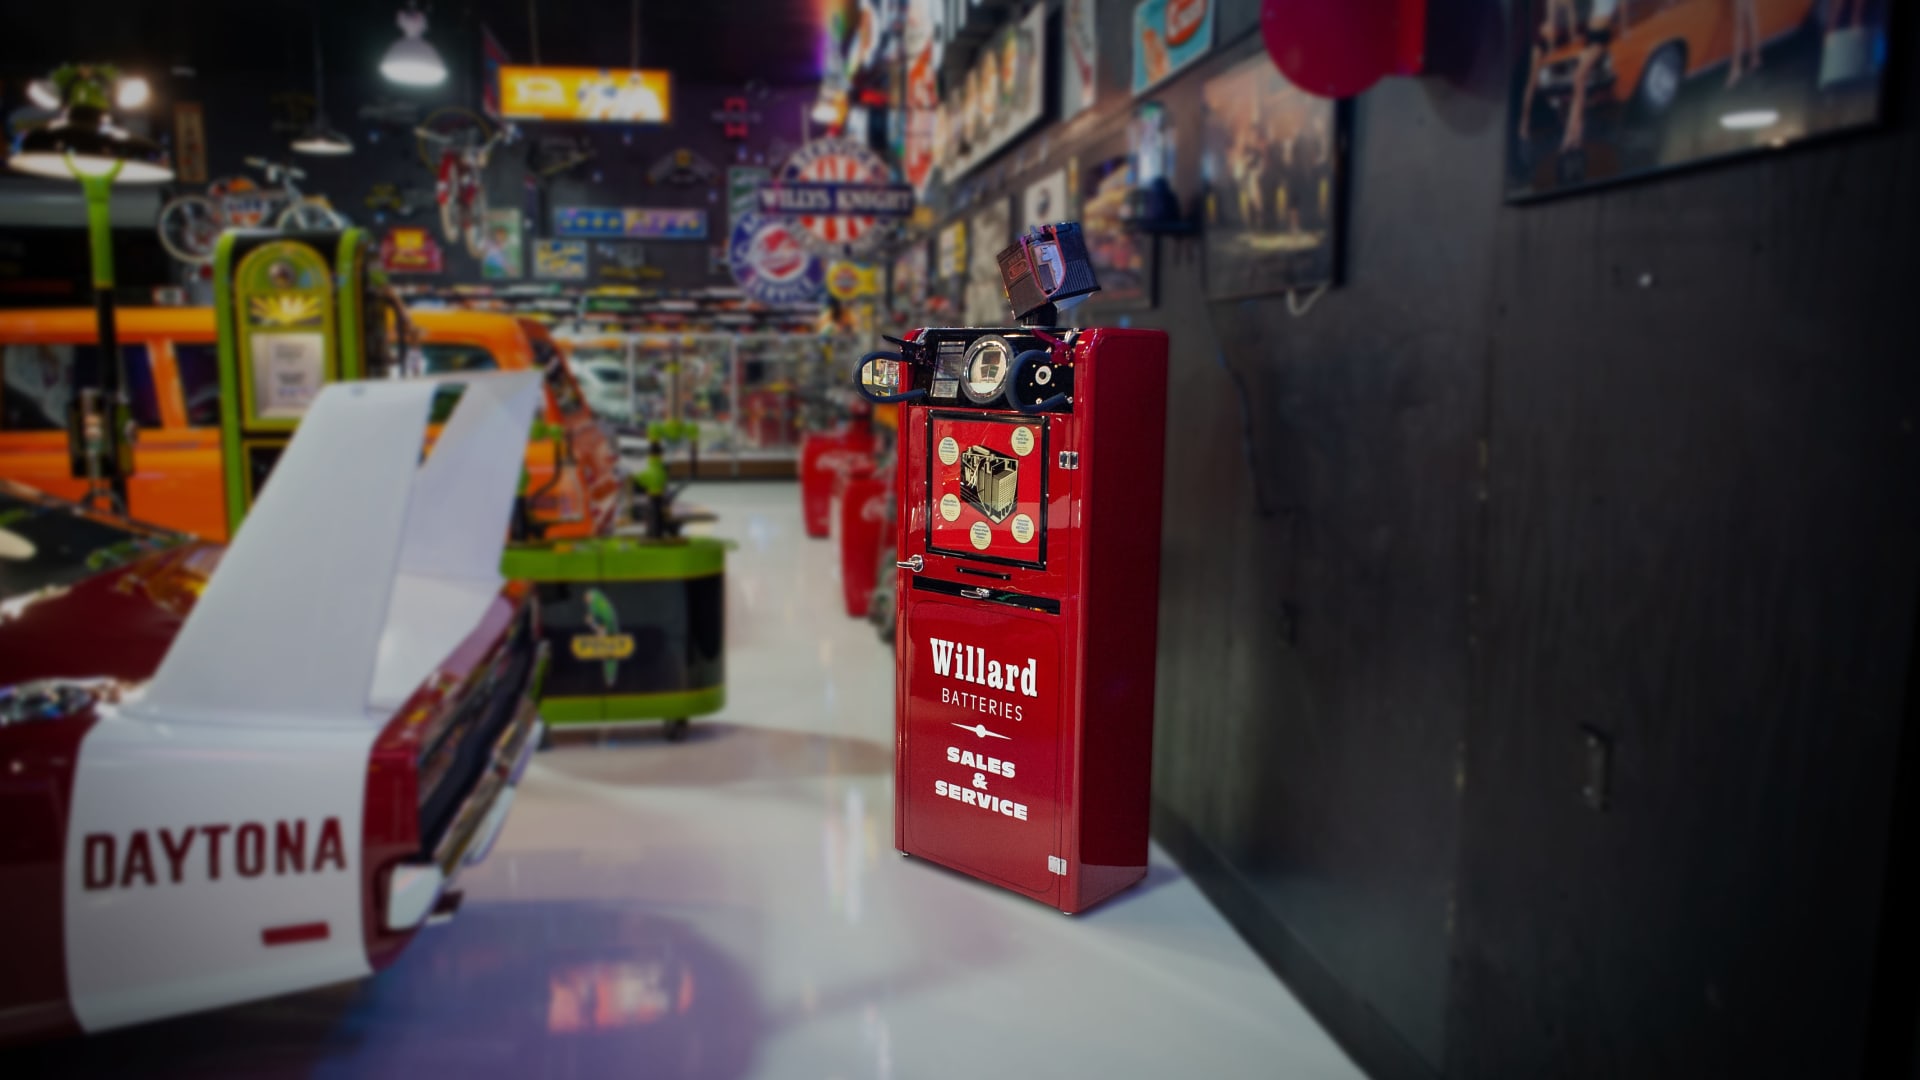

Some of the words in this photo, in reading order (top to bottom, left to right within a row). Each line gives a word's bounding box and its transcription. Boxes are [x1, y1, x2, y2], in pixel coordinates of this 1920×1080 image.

[760, 188, 831, 209] WILLYS
[836, 188, 911, 209] KNIGHT
[930, 637, 1037, 696] Willard
[942, 688, 1023, 721] BATTERIES
[946, 747, 1015, 778] SALES
[972, 772, 988, 790] &
[935, 780, 1028, 821] SERVICE
[83, 815, 346, 892] DAYTONA
